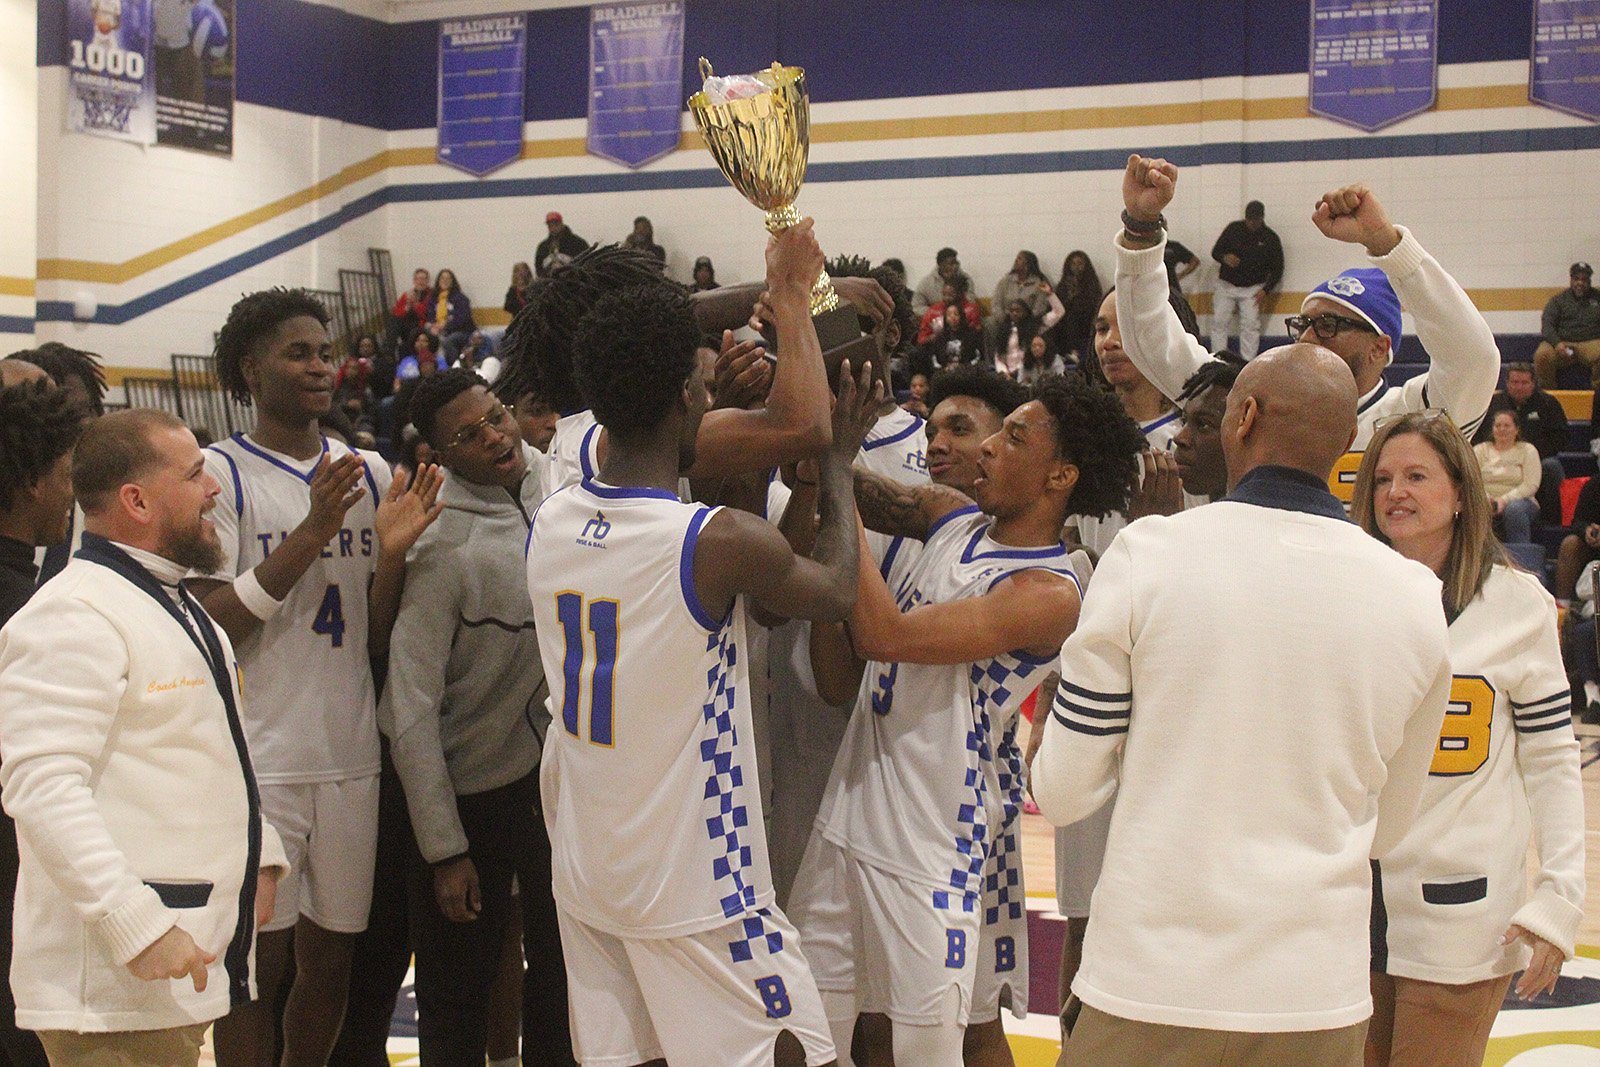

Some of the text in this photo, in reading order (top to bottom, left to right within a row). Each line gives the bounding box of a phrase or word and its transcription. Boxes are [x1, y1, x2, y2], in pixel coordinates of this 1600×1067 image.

[444, 15, 524, 35] BRADWELL
[595, 2, 681, 21] BRADWELL
[451, 29, 514, 46] BASEBALL
[70, 40, 145, 79] 1000
[257, 527, 373, 559] TRS
[576, 538, 588, 546] RISE
[593, 541, 607, 549] BALL
[312, 584, 346, 648] 4
[147, 679, 177, 693] Coach
[553, 588, 621, 749] 11
[1429, 673, 1496, 776] B
[945, 928, 967, 969] B
[995, 935, 1016, 973] B
[754, 974, 793, 1019] B
